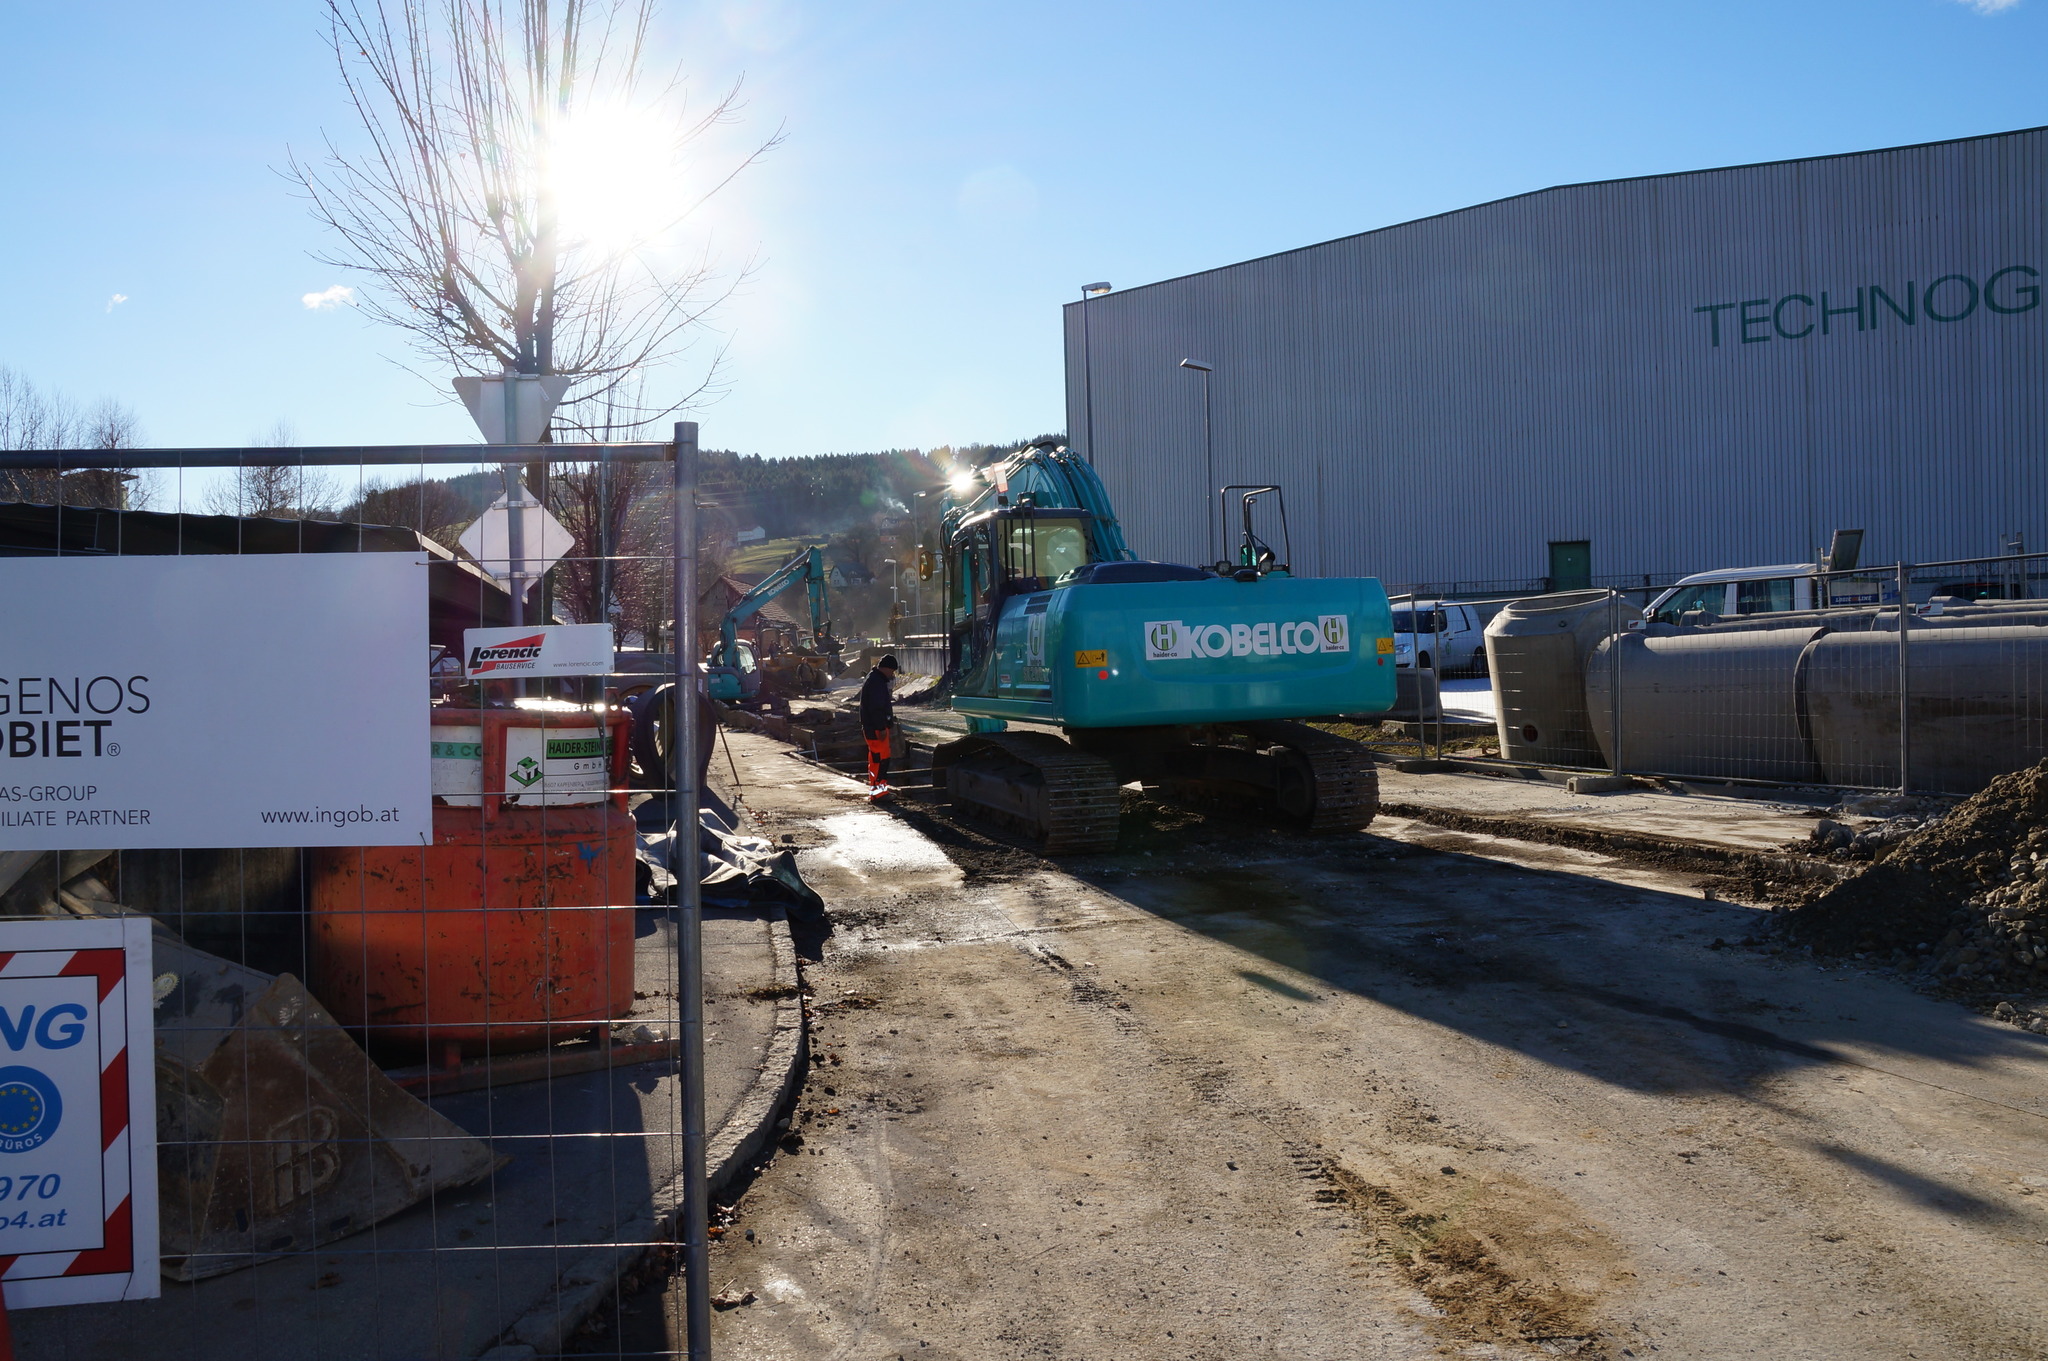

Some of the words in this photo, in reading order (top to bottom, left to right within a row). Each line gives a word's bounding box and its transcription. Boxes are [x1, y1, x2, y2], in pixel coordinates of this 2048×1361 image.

[1693, 265, 2041, 348] TECHNOG
[1182, 621, 1320, 658] KOBELCO
[467, 643, 542, 669] Lorencic
[495, 662, 536, 670] BAUSERVICE
[553, 660, 604, 668] www.lorencic.com
[0, 676, 150, 715] GENOS
[2, 811, 56, 827] ILIATE
[66, 809, 151, 826] PARTNER
[260, 804, 400, 828] www.ingob.at
